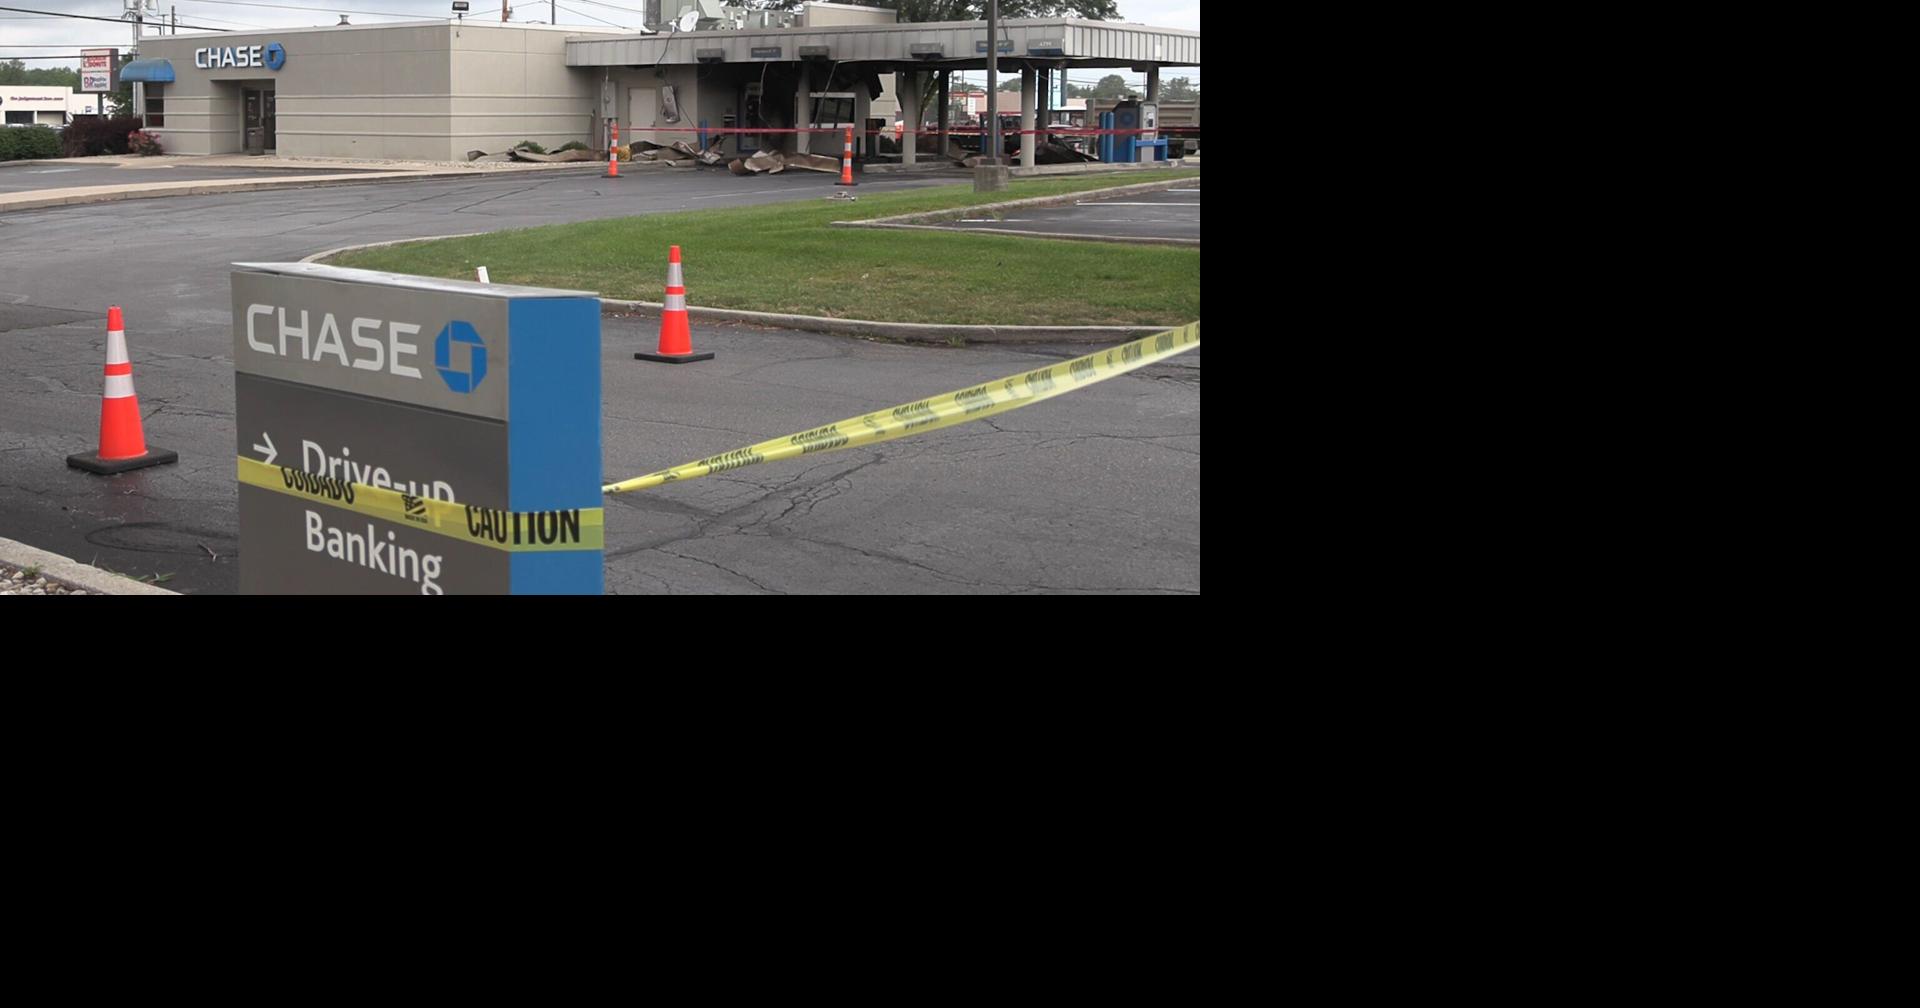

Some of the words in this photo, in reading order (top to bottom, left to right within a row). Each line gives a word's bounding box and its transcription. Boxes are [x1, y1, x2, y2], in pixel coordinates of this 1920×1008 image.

[195, 45, 262, 68] CHASE
[246, 303, 423, 379] CHASE
[305, 510, 444, 596] Banking
[464, 505, 580, 545] CAUTION
